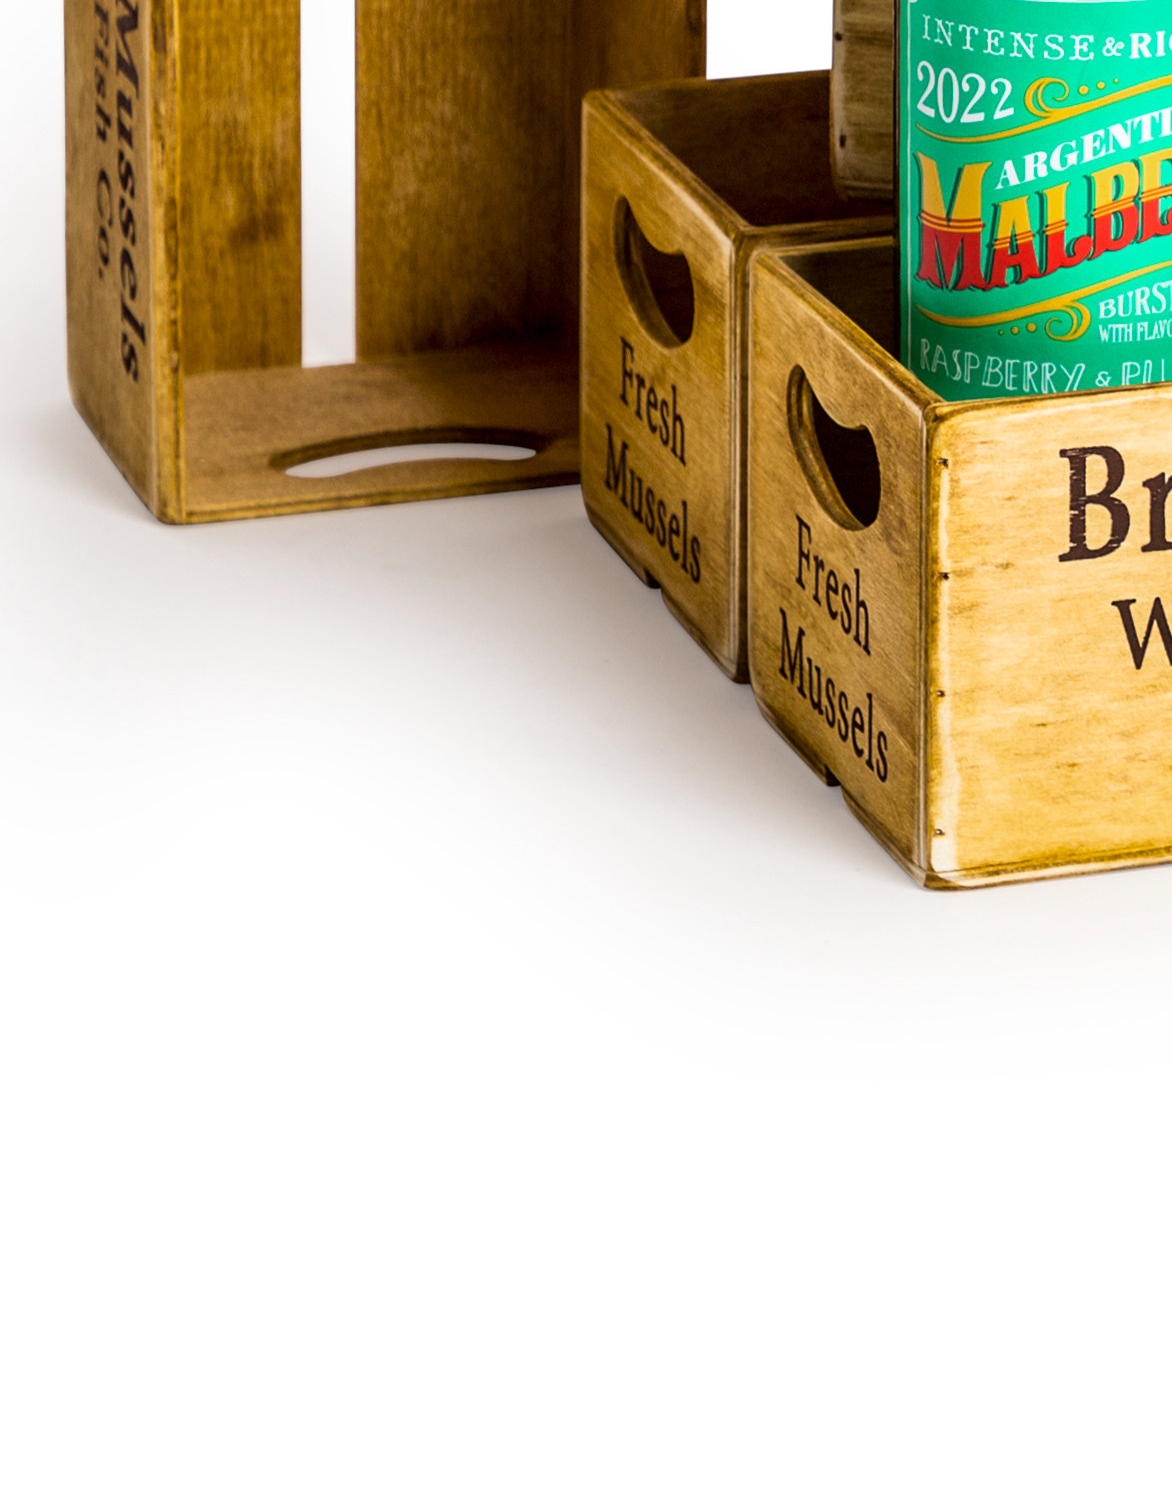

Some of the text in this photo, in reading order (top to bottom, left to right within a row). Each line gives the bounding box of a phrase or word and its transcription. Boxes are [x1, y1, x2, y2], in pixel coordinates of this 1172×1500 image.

[916, 60, 1015, 124] 2022
[921, 15, 1095, 61] INTENSE
[1102, 36, 1125, 58] &
[97, 167, 114, 280] Co.
[919, 338, 1086, 394] RASPBERRY
[1095, 371, 1112, 387] &
[1098, 322, 1133, 343] WITH
[619, 336, 687, 466] Fresh
[603, 423, 702, 585] Mussels
[795, 514, 872, 657] Fresh
[778, 607, 889, 783] Mussels
